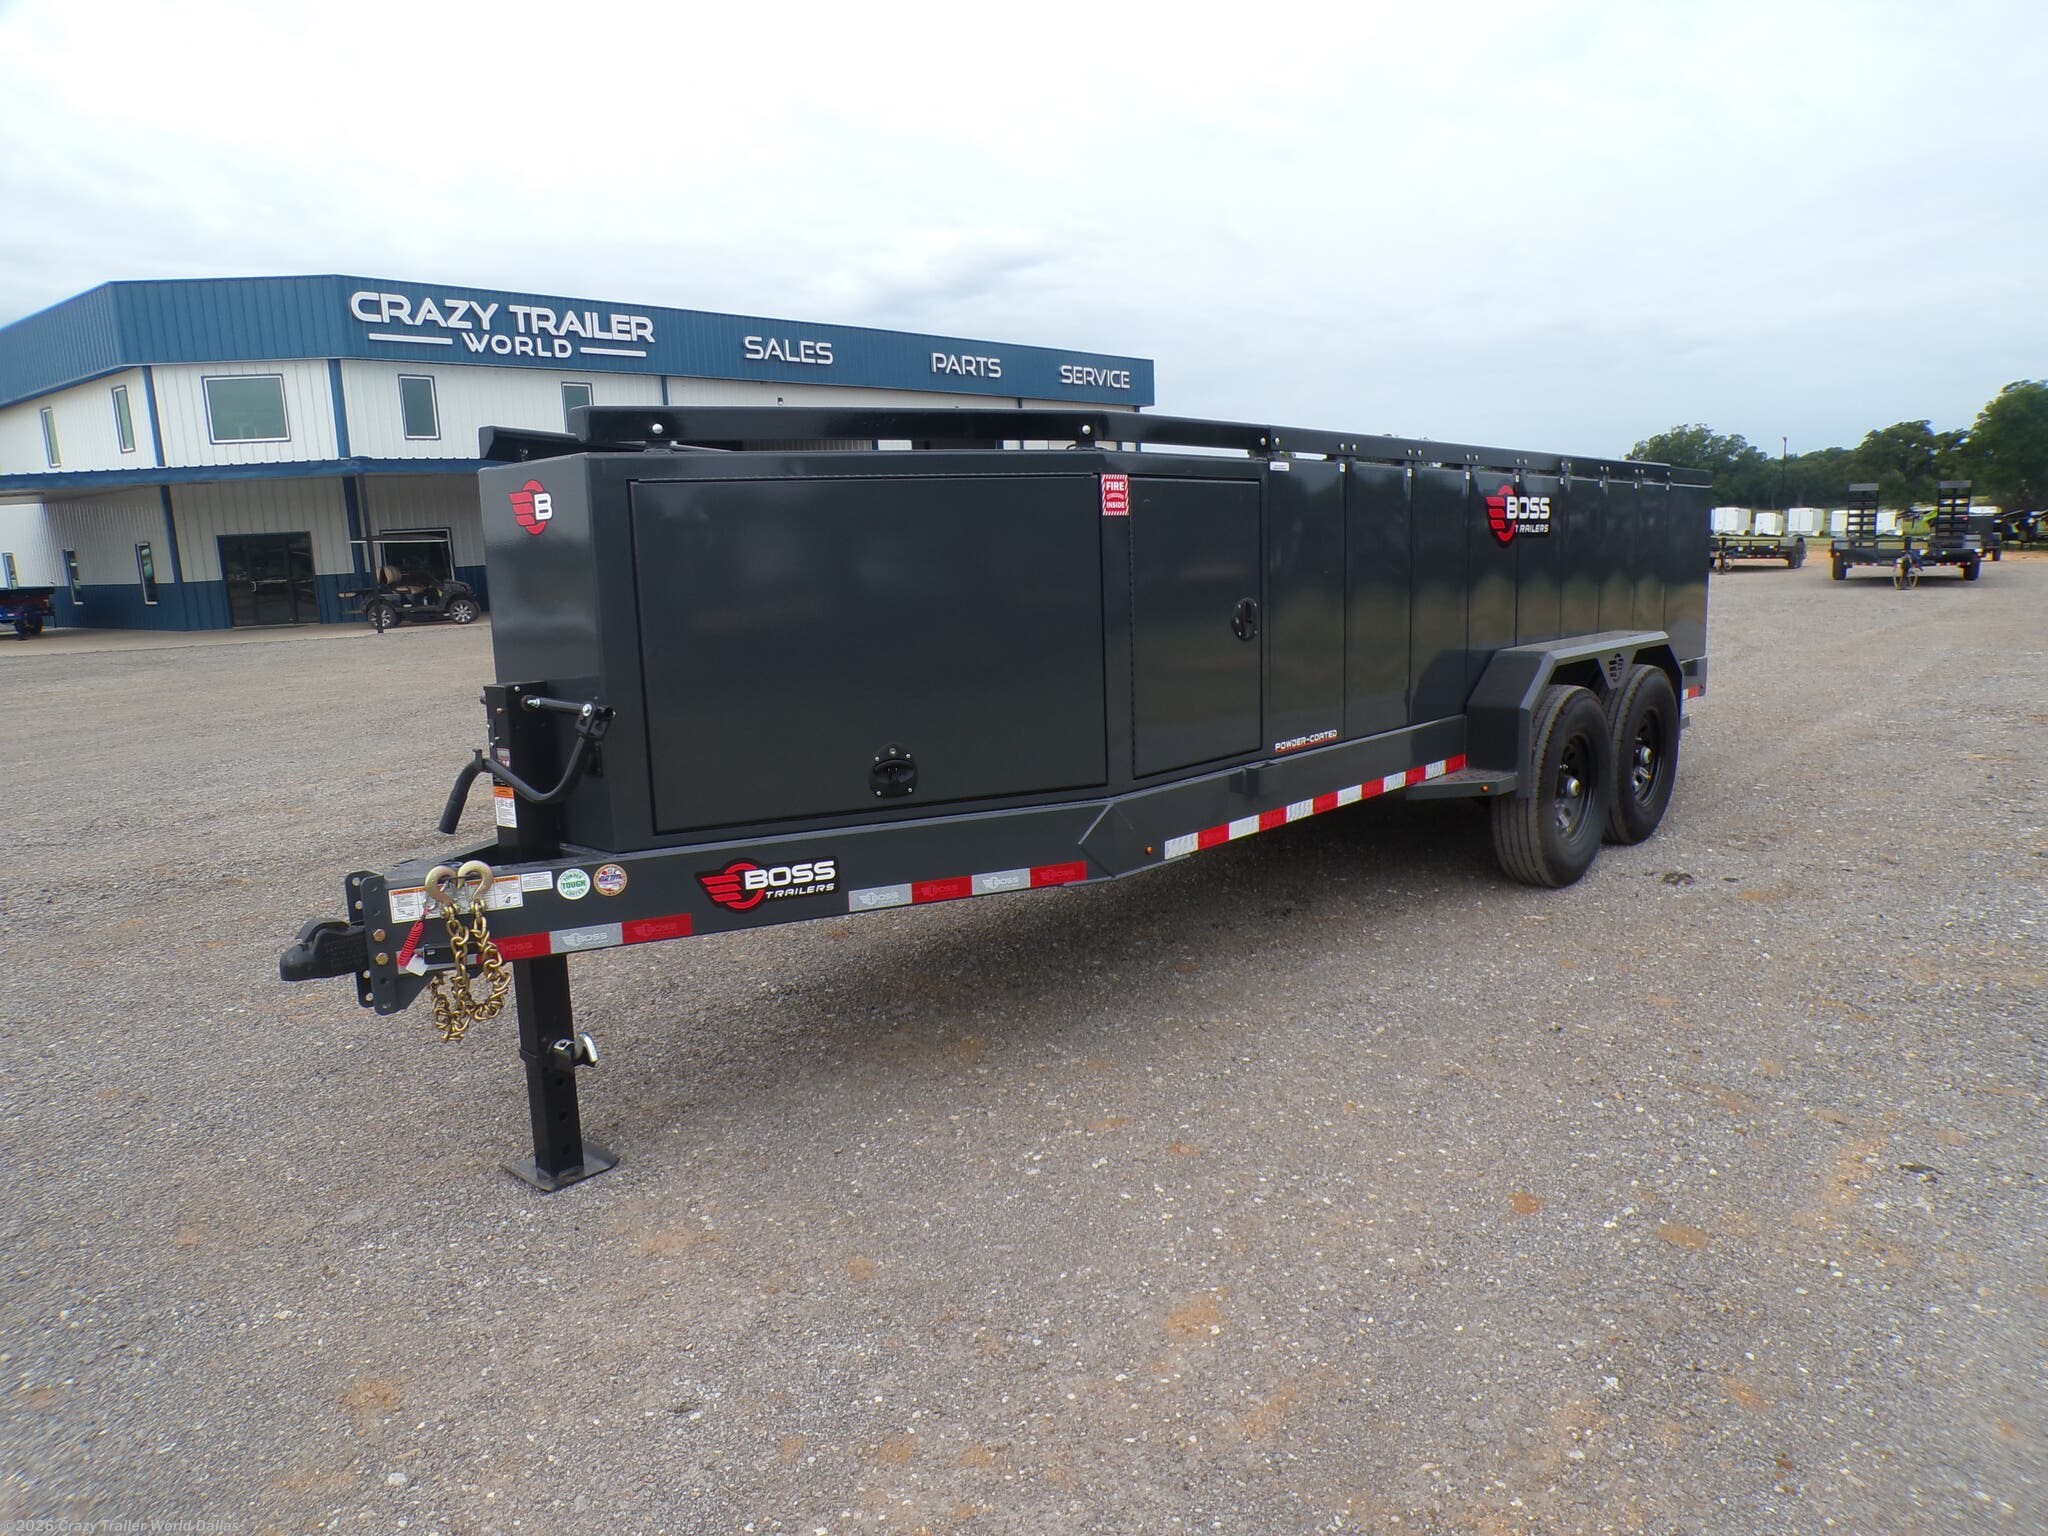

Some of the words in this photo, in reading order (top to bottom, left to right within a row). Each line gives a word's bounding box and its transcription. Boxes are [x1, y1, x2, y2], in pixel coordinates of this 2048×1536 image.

[350, 291, 499, 331] CRAZY
[508, 304, 656, 343] TRAILER
[461, 332, 573, 359] WORLD
[743, 335, 834, 365] SALES
[931, 351, 1002, 378] PARTS
[1060, 364, 1131, 389] SERVICE
[1106, 481, 1124, 491] FIRE
[534, 492, 553, 520] B
[1506, 496, 1550, 519] BOSS
[1515, 524, 1550, 533] TRAILERS
[1274, 729, 1338, 751] POWDER-COATED
[561, 880, 586, 889] TOUGH
[744, 860, 836, 890] BOSS
[765, 882, 835, 899] TRAILERS
